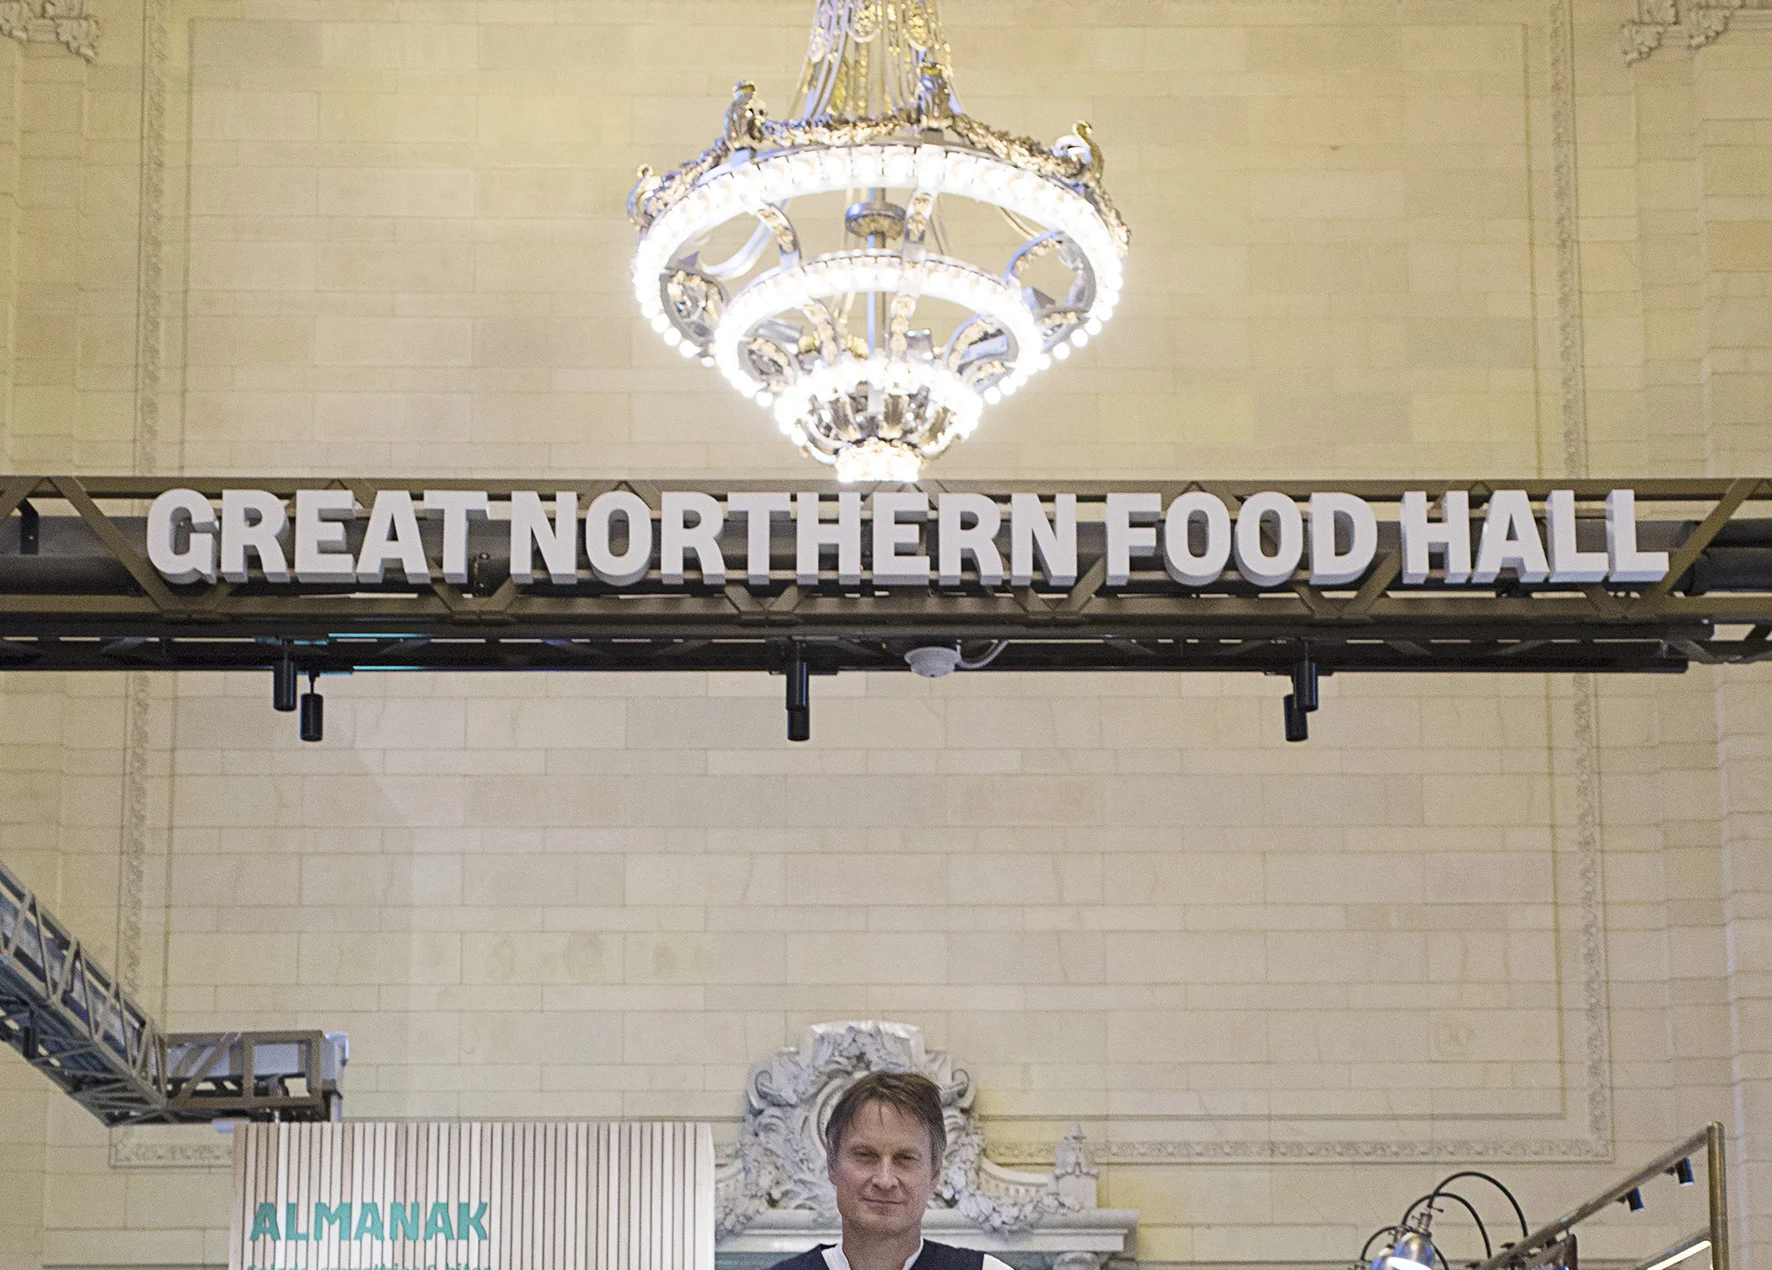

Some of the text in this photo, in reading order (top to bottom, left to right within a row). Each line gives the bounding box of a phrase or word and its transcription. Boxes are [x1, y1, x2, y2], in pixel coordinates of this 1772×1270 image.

[146, 488, 1669, 586] GREAT NORTHERN FOOD HALL
[250, 1202, 488, 1241] ALMANAK
